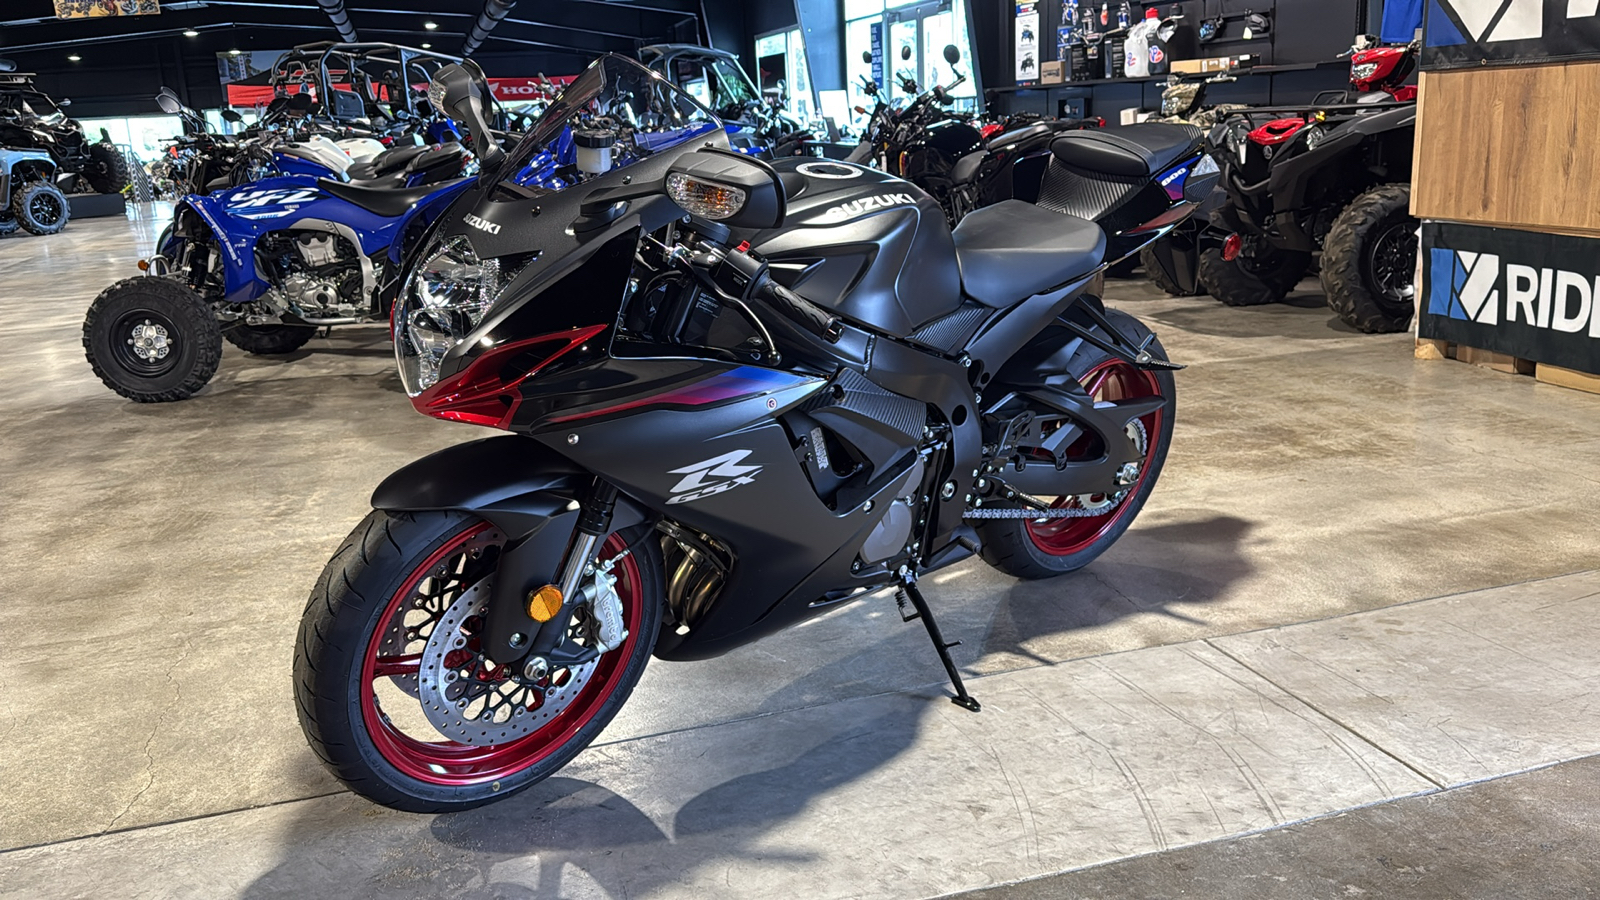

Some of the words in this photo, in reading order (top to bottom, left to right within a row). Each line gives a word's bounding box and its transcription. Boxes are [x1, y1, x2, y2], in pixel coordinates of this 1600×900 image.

[227, 187, 320, 208] YFZ
[825, 193, 917, 217] SUZUKI
[462, 212, 502, 235] SUZUKI
[665, 449, 763, 493] R
[664, 469, 764, 505] GSX
[602, 595, 619, 641] brembo
